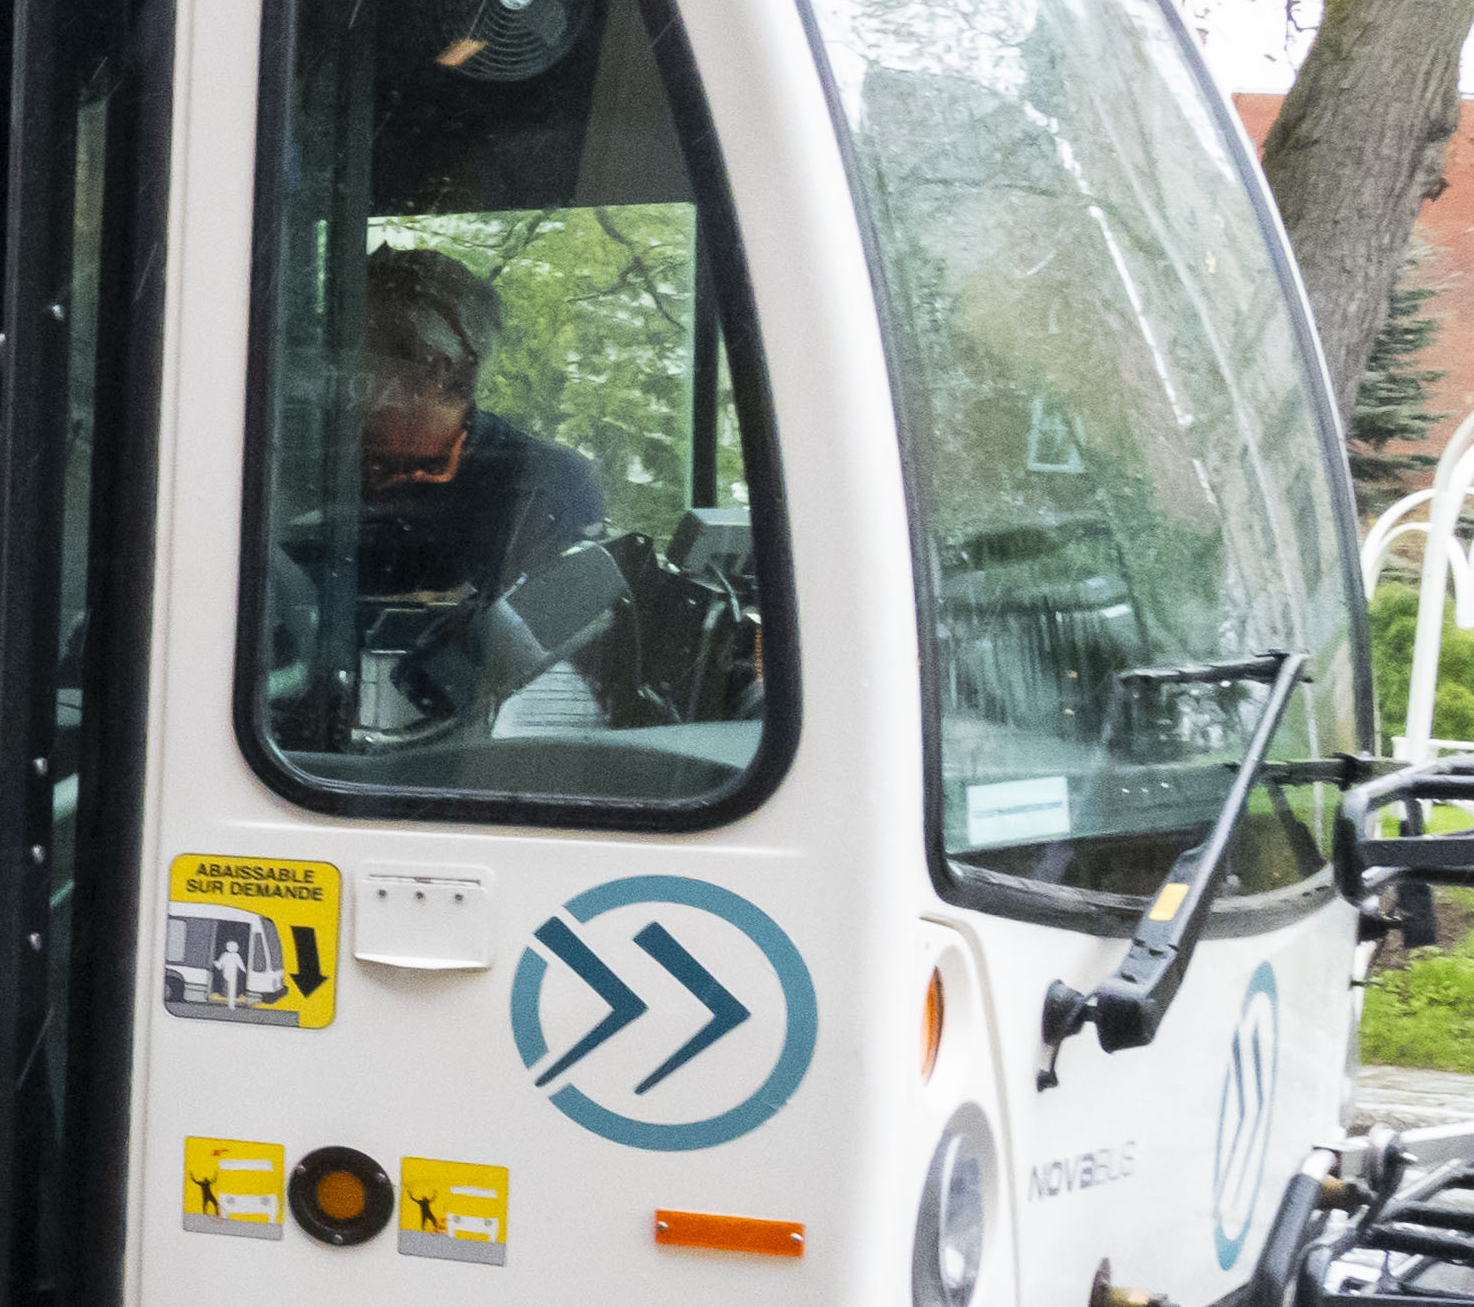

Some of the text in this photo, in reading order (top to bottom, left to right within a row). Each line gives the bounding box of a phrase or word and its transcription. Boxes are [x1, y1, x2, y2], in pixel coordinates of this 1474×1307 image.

[195, 862, 316, 884] ABAISSABLE
[186, 878, 325, 902] SUR DEMANDE
